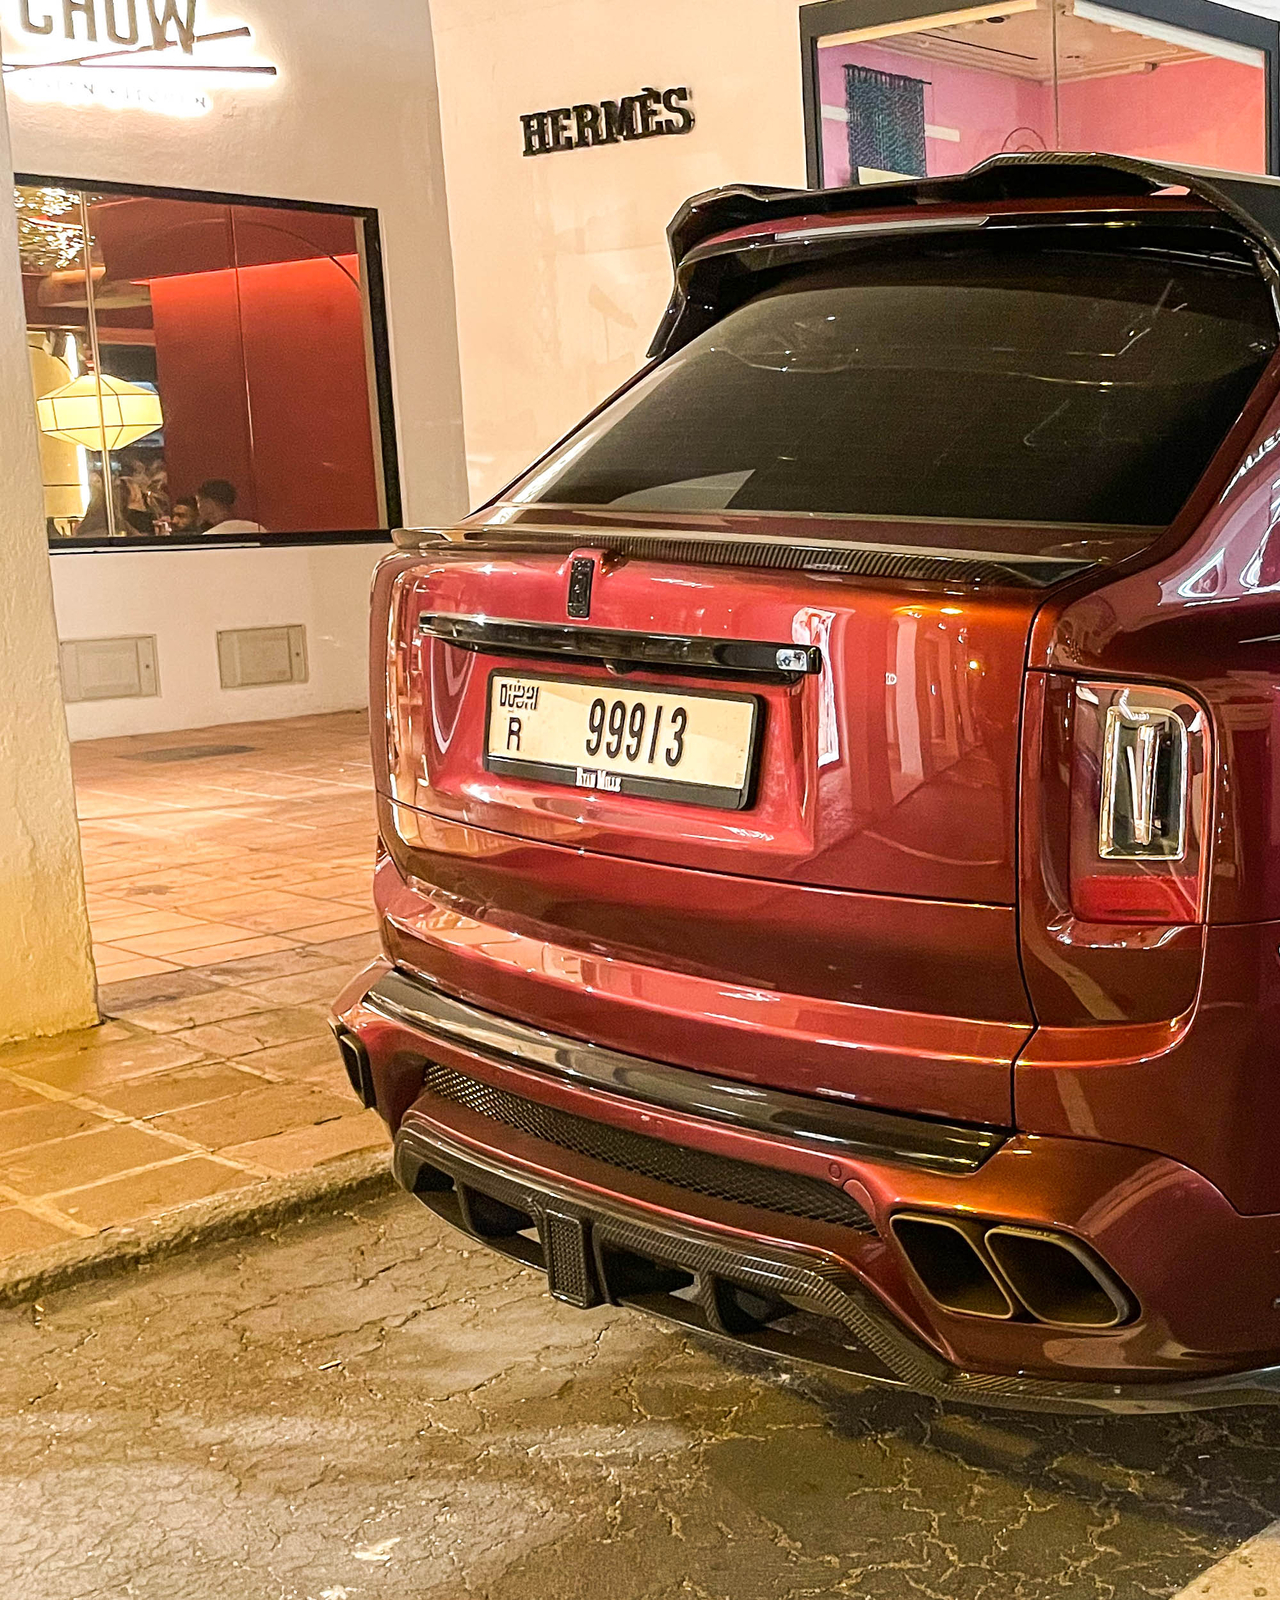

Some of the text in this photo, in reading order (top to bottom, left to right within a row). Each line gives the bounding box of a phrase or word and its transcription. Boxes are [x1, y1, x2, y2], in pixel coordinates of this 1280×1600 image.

[520, 87, 696, 156] HERMÈS
[507, 716, 522, 751] R
[585, 697, 687, 767] 99913
